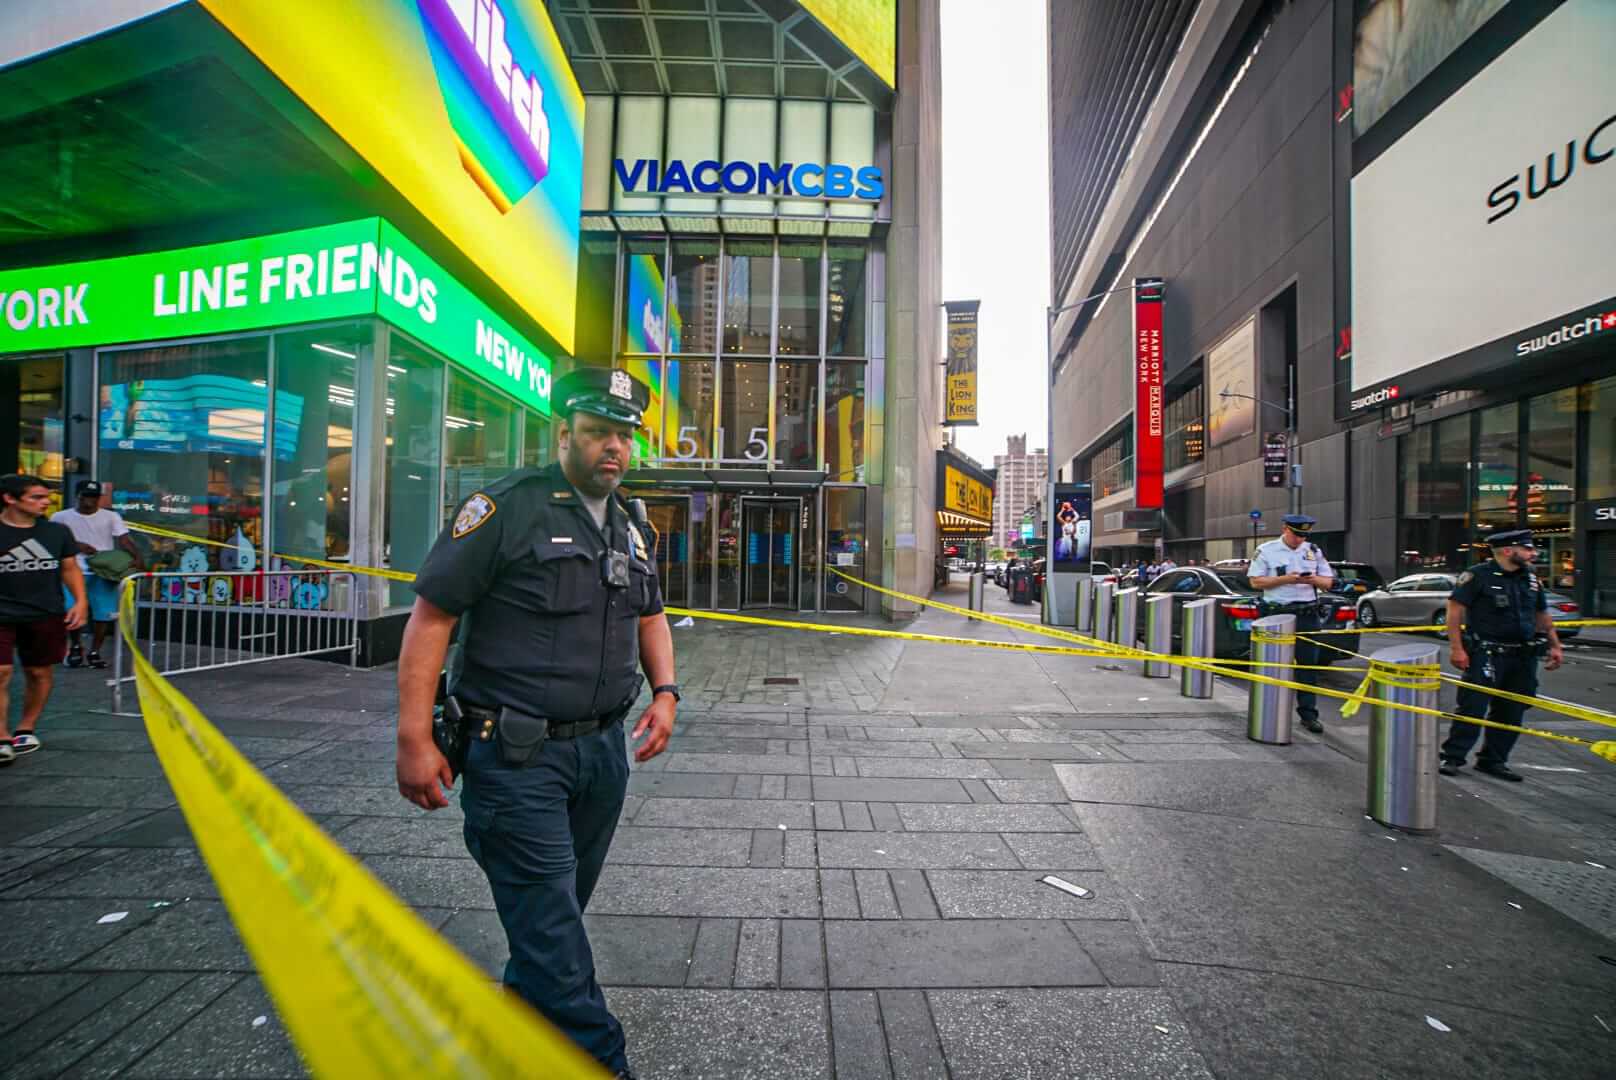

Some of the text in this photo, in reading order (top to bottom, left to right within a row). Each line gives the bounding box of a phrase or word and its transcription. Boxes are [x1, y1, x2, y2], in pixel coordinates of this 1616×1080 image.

[613, 158, 885, 199] VIACOMCBS
[153, 241, 438, 324] LINE FRIENDS
[475, 319, 525, 382] NEW
[1139, 329, 1149, 383] NEW YORK
[1516, 313, 1602, 357] swatch
[950, 389, 972, 401] LION
[953, 379, 968, 388] THE
[1150, 329, 1161, 436] MARRIOTT MARQUIS
[1351, 387, 1391, 411] swatch
[948, 401, 976, 416] KING
